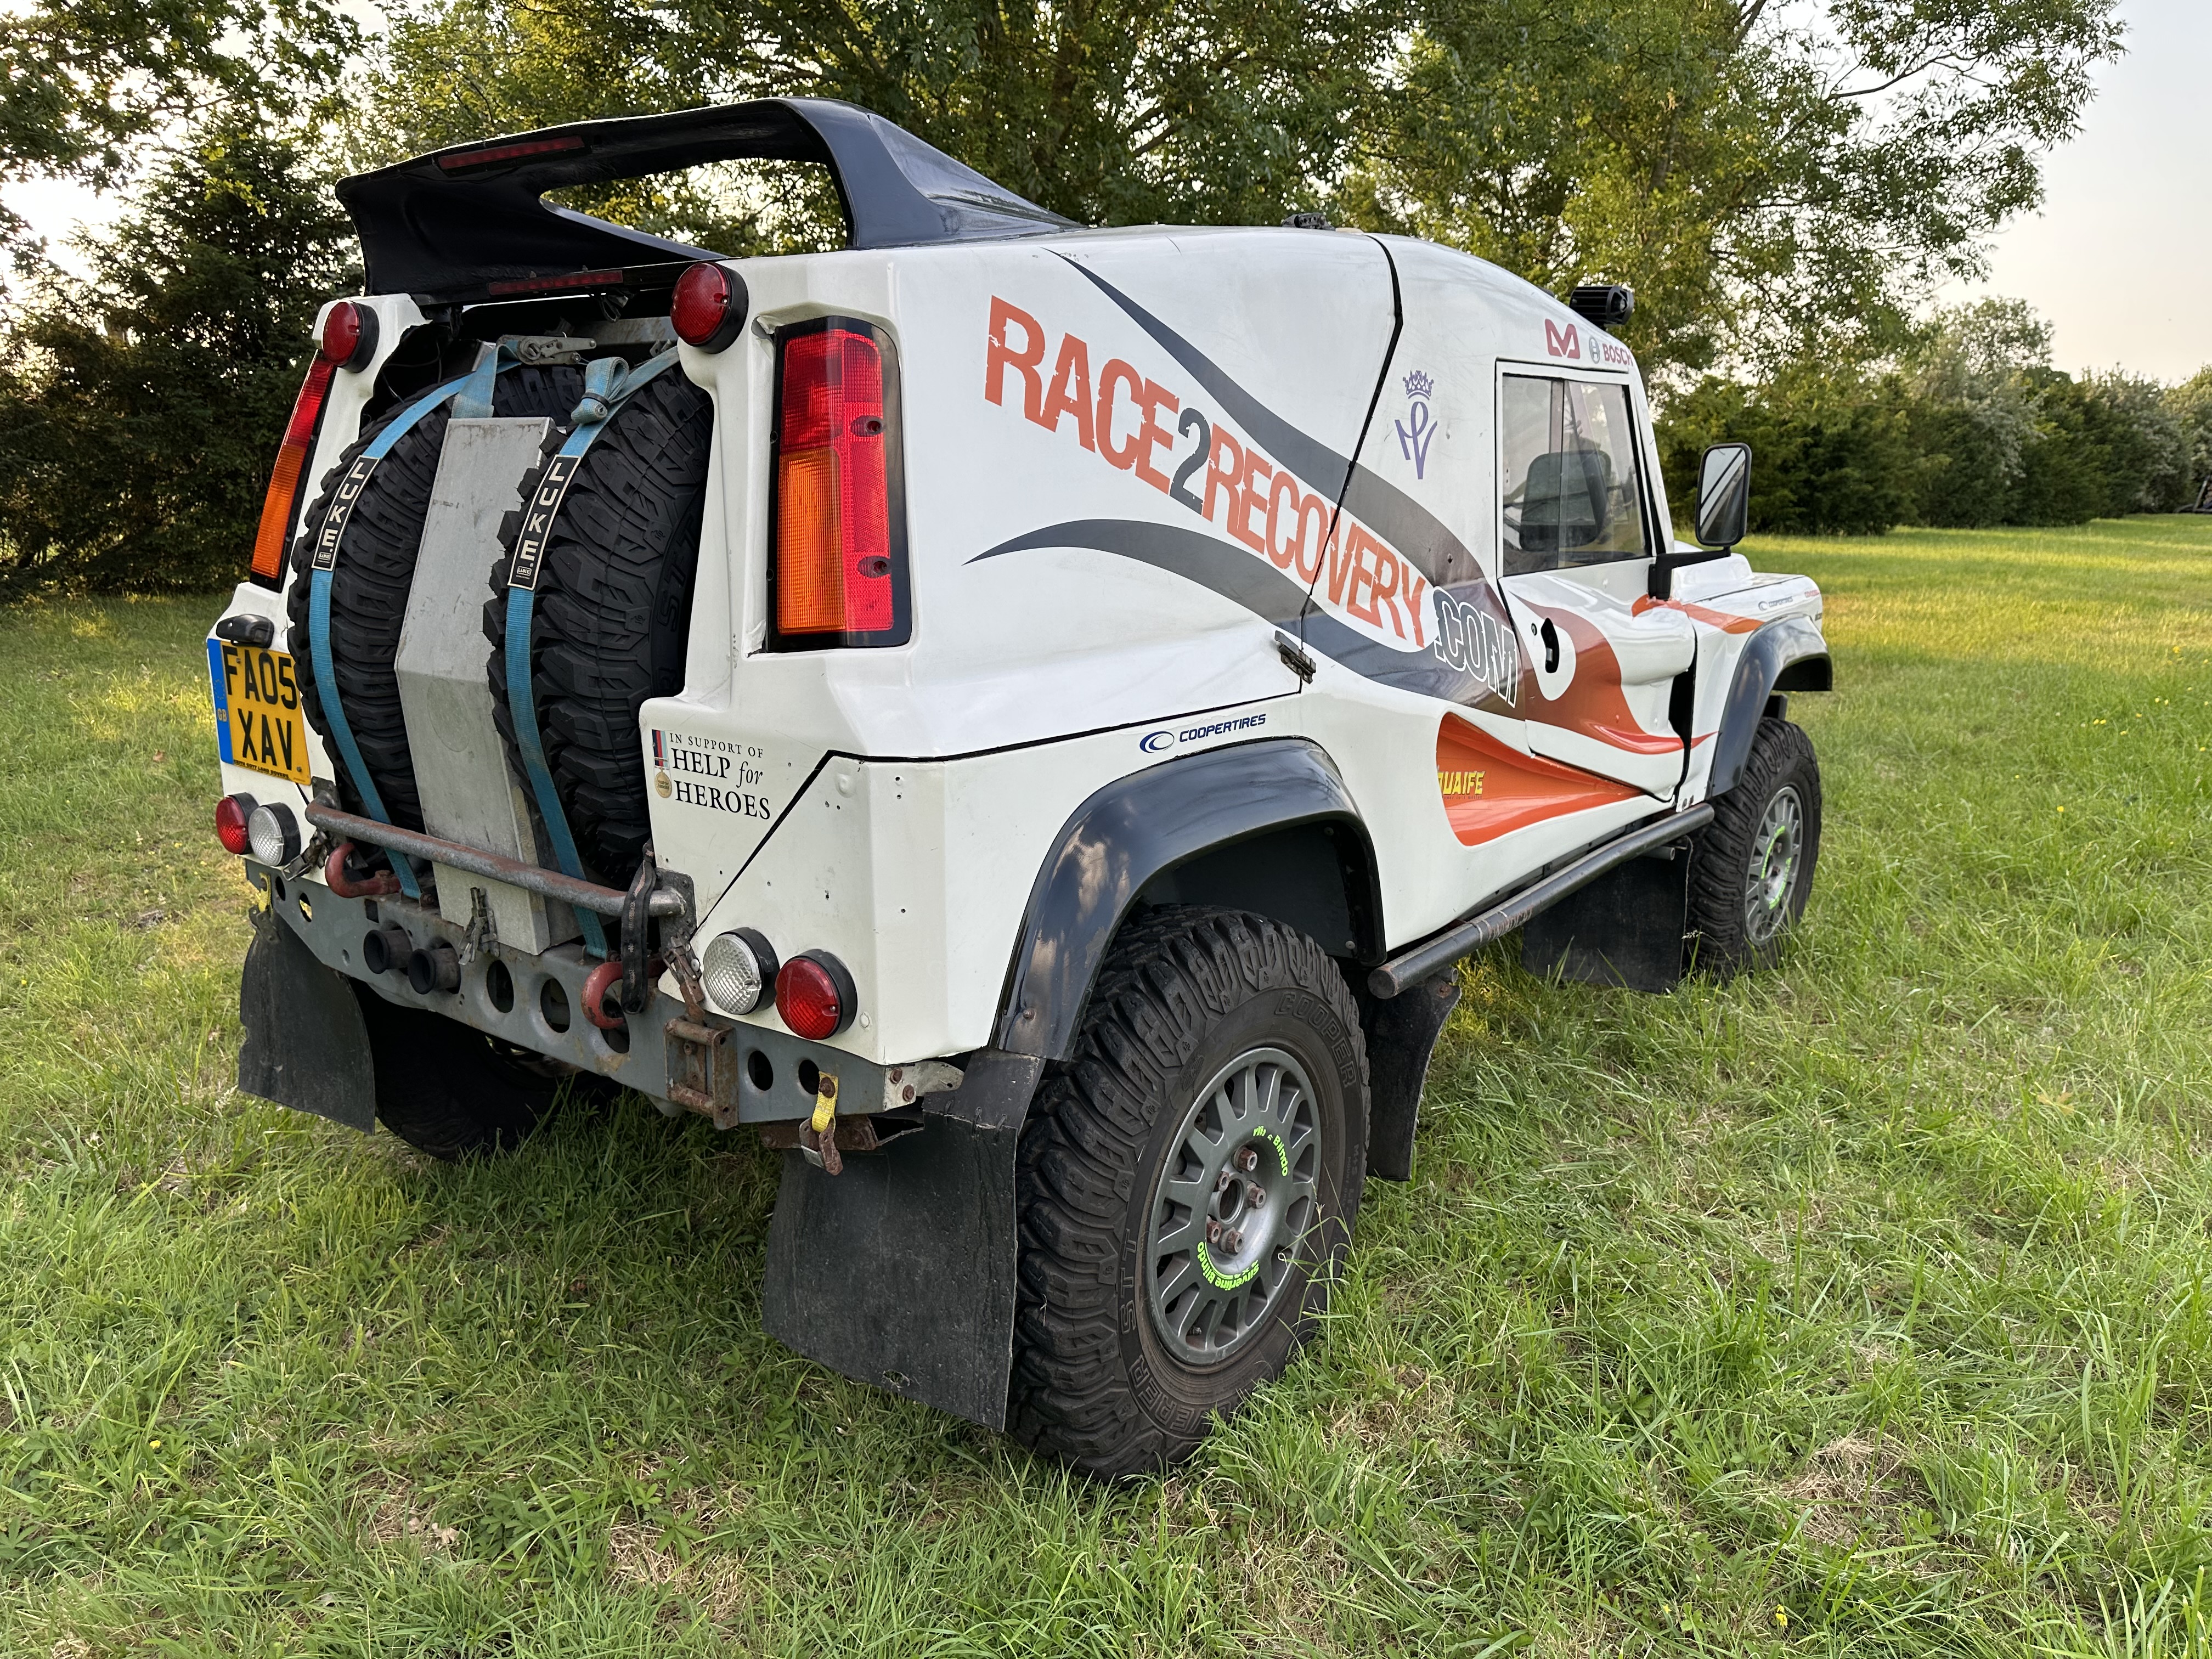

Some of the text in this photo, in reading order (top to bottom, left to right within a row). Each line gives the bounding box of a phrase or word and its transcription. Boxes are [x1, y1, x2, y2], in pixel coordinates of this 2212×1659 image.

[1602, 343, 1633, 366] BOSCH
[322, 462, 365, 547] LUKE
[520, 462, 565, 561] LUKE
[222, 645, 297, 710] FA05
[217, 708, 227, 722] GB
[238, 708, 292, 771] XAV
[670, 733, 763, 758] IN SUPPORT OF
[671, 748, 763, 788] HELP for
[674, 780, 770, 820] HEROES
[1274, 991, 1357, 1088] COOPER
[1273, 1135, 1288, 1177] Blindo
[1120, 1228, 1137, 1334] STT
[1197, 1242, 1259, 1291] Silverline Blindo
